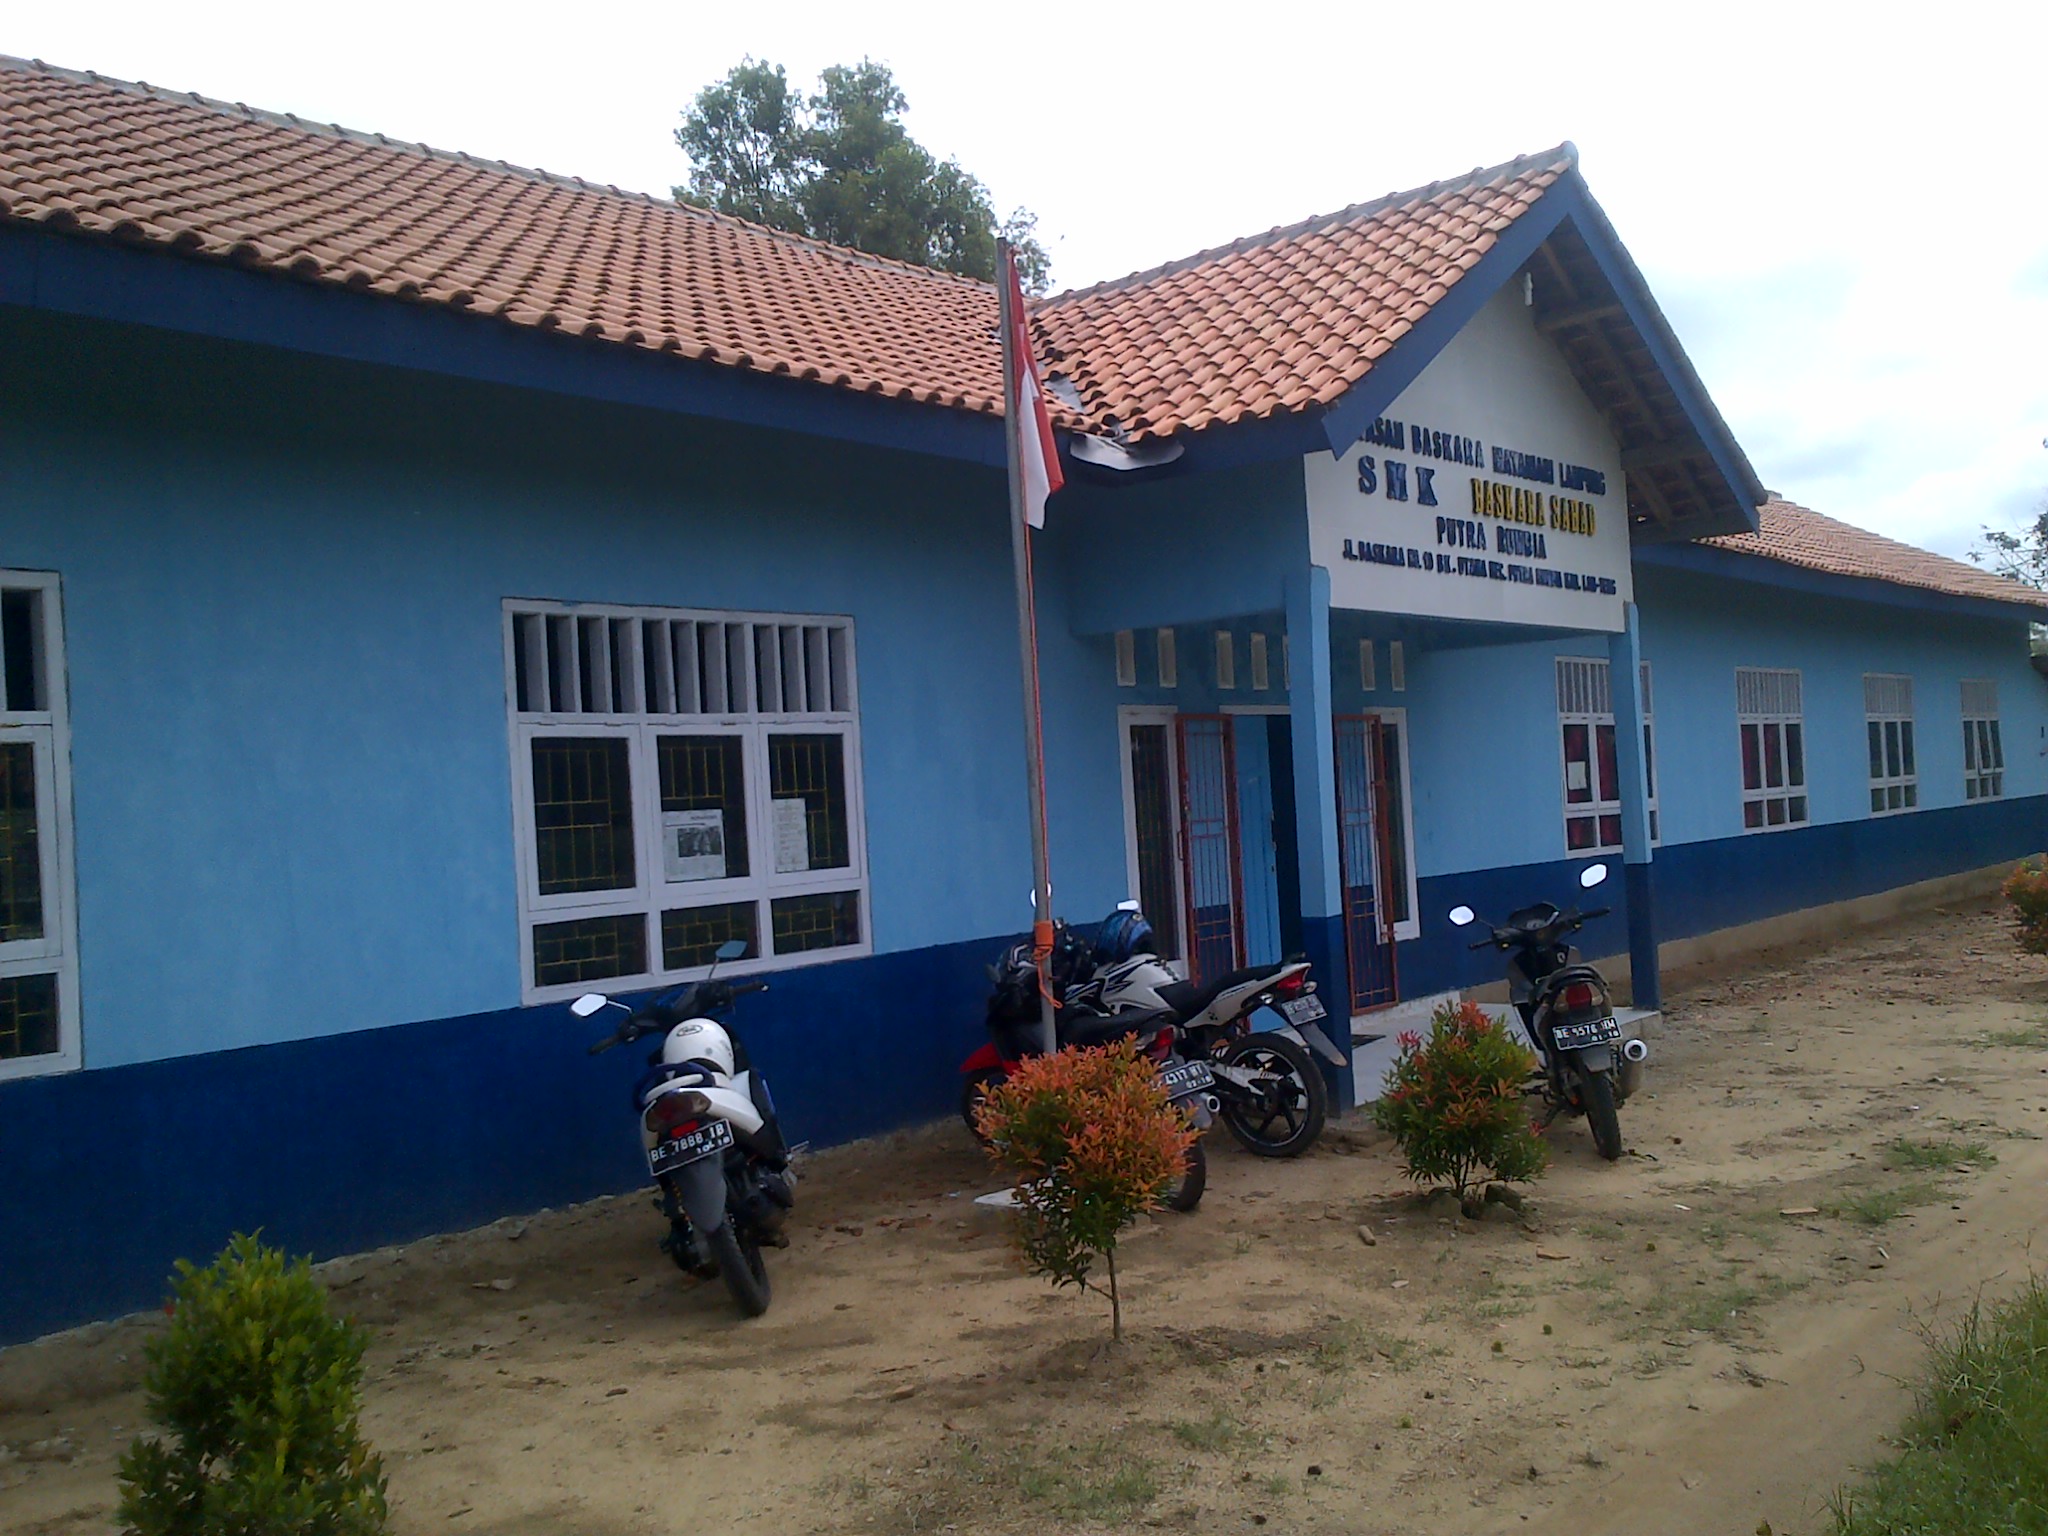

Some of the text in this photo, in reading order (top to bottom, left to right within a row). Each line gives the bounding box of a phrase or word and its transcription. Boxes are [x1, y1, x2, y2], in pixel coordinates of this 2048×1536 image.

[1411, 425, 1485, 468] BASKARA
[1470, 478, 1546, 527] BASKARA
[1358, 541, 1405, 567] BASKARA
[1436, 516, 1547, 559] PUTRA RUMBIA
[651, 1146, 668, 1163] BE
[671, 1132, 704, 1153] 7888
